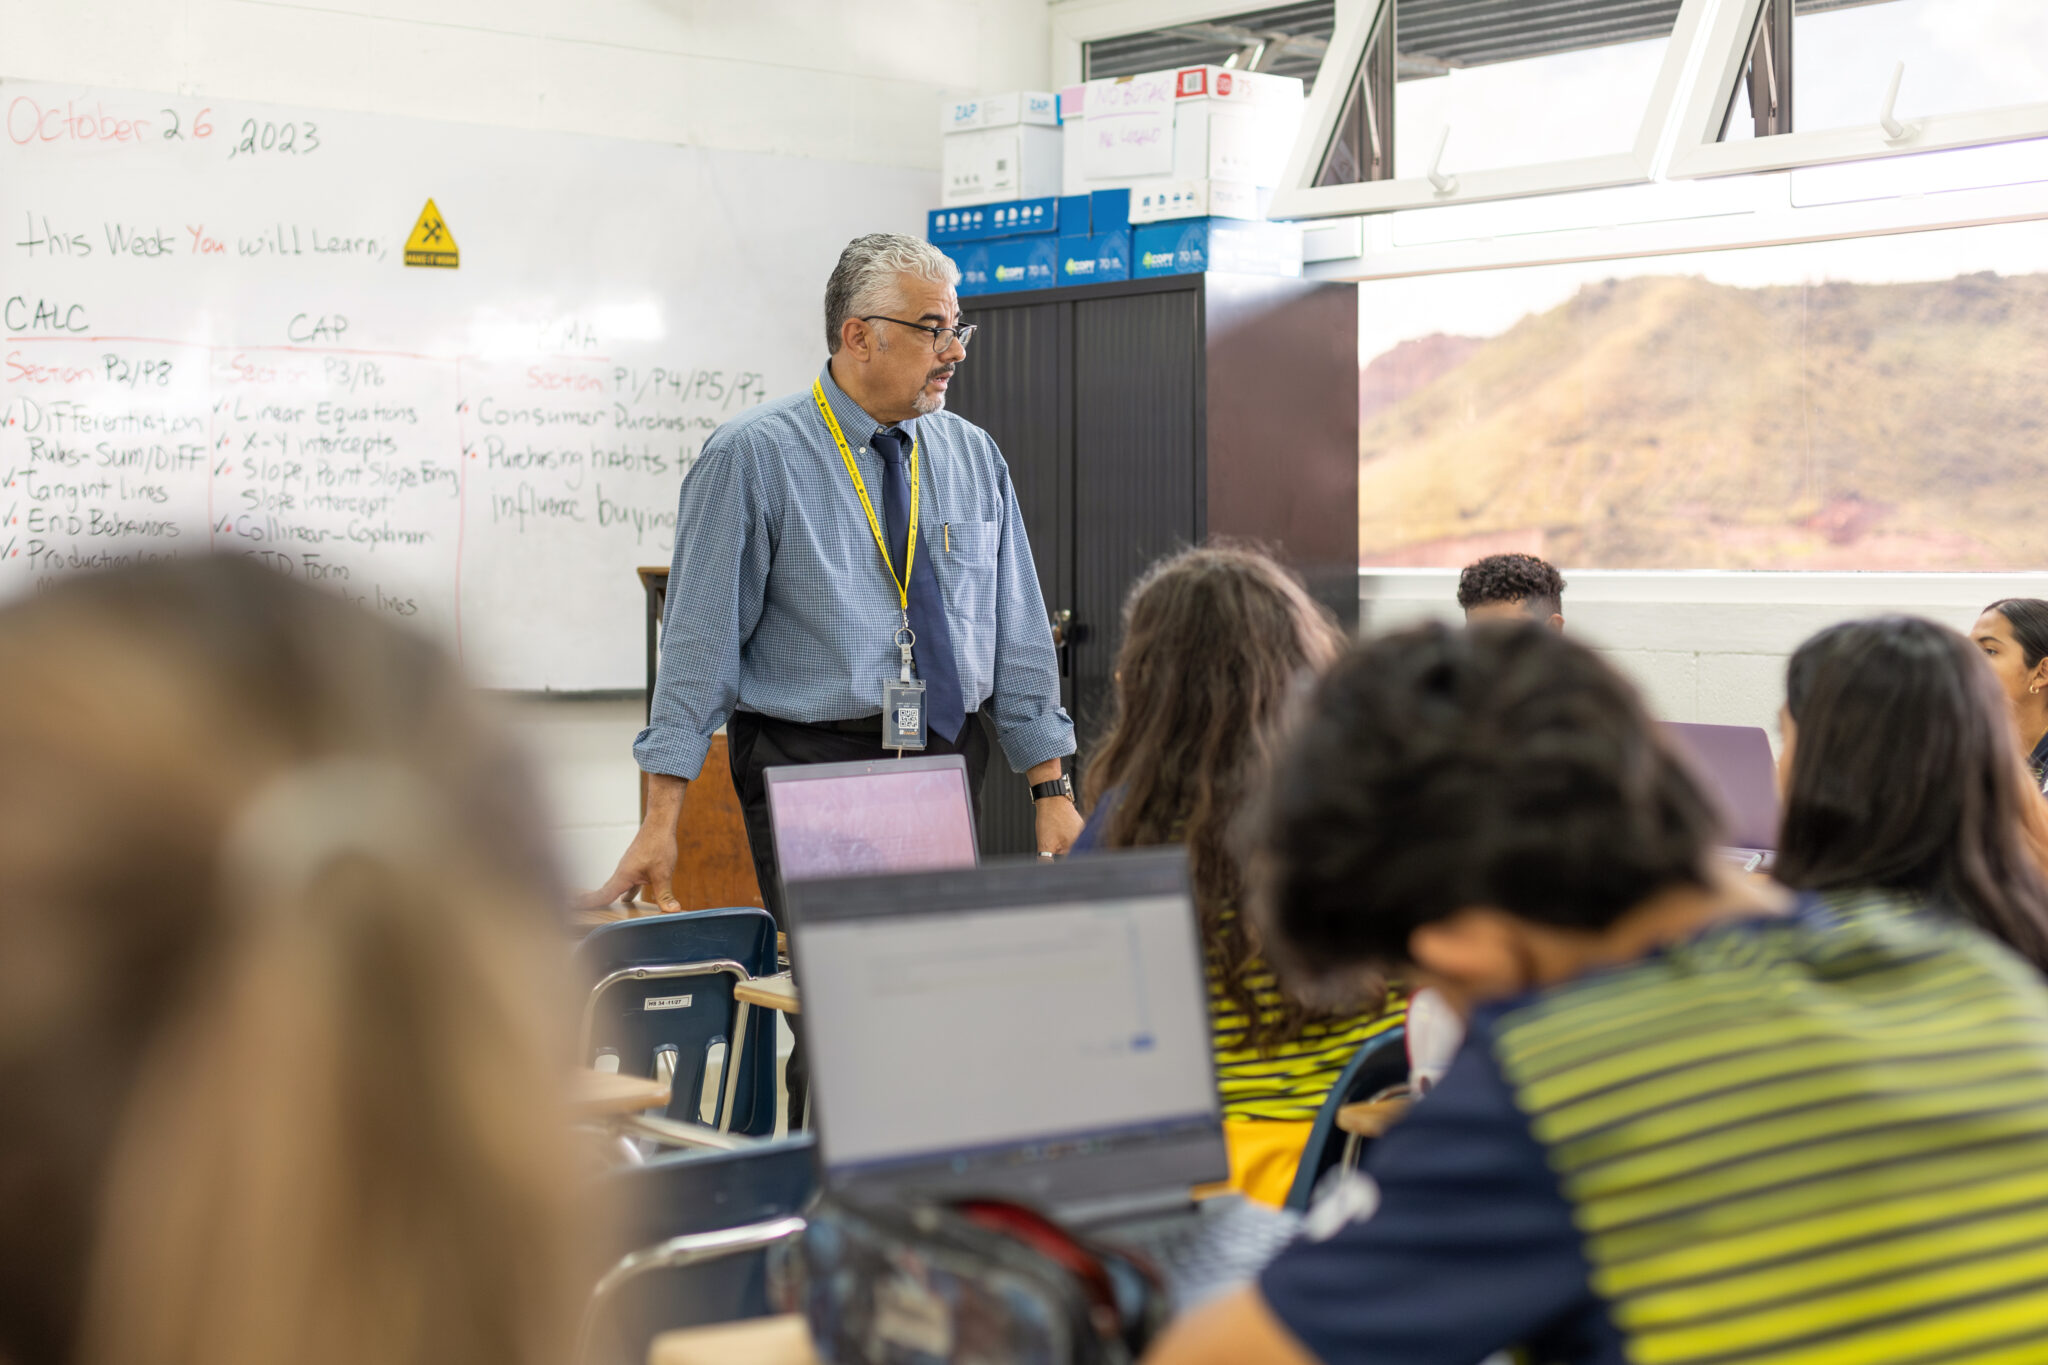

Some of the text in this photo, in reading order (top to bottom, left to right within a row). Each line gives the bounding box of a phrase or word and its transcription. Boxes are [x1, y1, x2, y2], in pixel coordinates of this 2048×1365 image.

[8, 96, 150, 145] October
[104, 223, 176, 257] Week
[187, 224, 226, 255] You
[4, 296, 90, 332] CALC
[288, 313, 349, 343] CAP
[102, 353, 173, 389] P2/P8
[234, 394, 418, 434] Linear Equations
[478, 396, 606, 426] Consumer
[591, 442, 668, 475] habits
[27, 538, 129, 571] Production
[302, 554, 350, 581] Form
